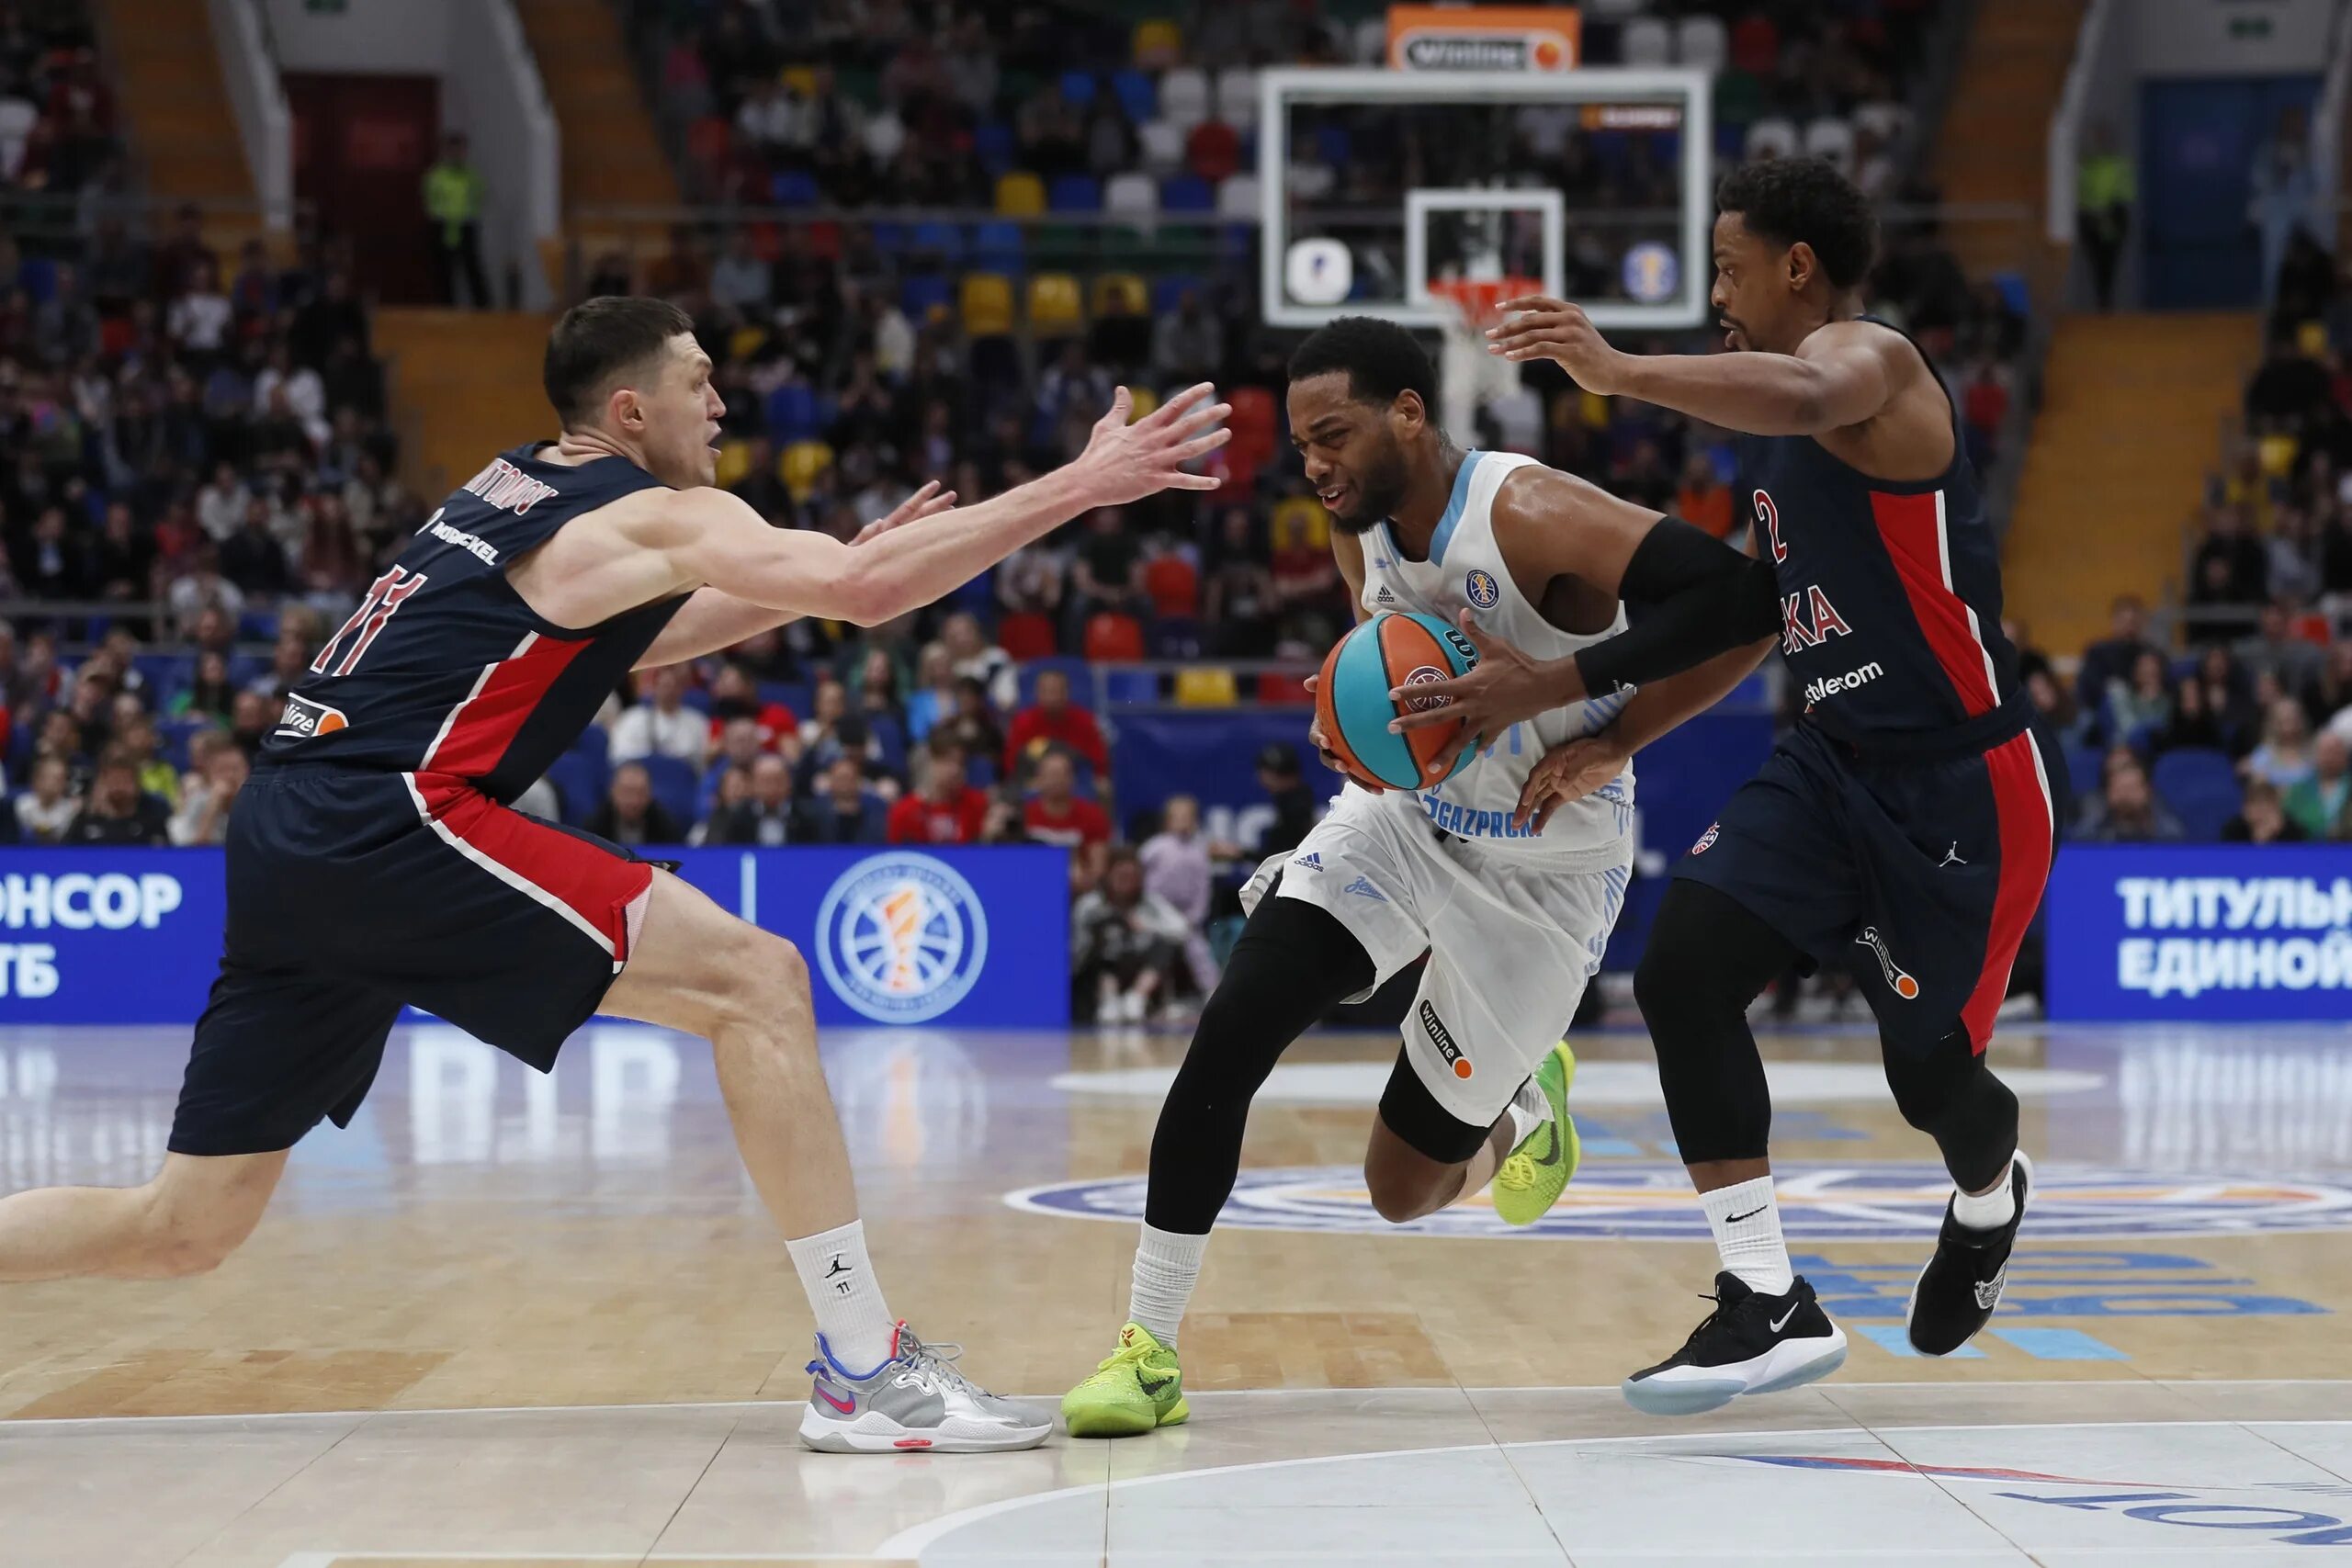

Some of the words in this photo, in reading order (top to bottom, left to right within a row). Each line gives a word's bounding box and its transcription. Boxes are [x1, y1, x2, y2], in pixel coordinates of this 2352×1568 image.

[1753, 489, 1787, 564] 2
[310, 563, 428, 677] 11
[0, 873, 183, 930] НСОР
[1422, 1003, 1455, 1059] Winline
[836, 1280, 851, 1294] 11
